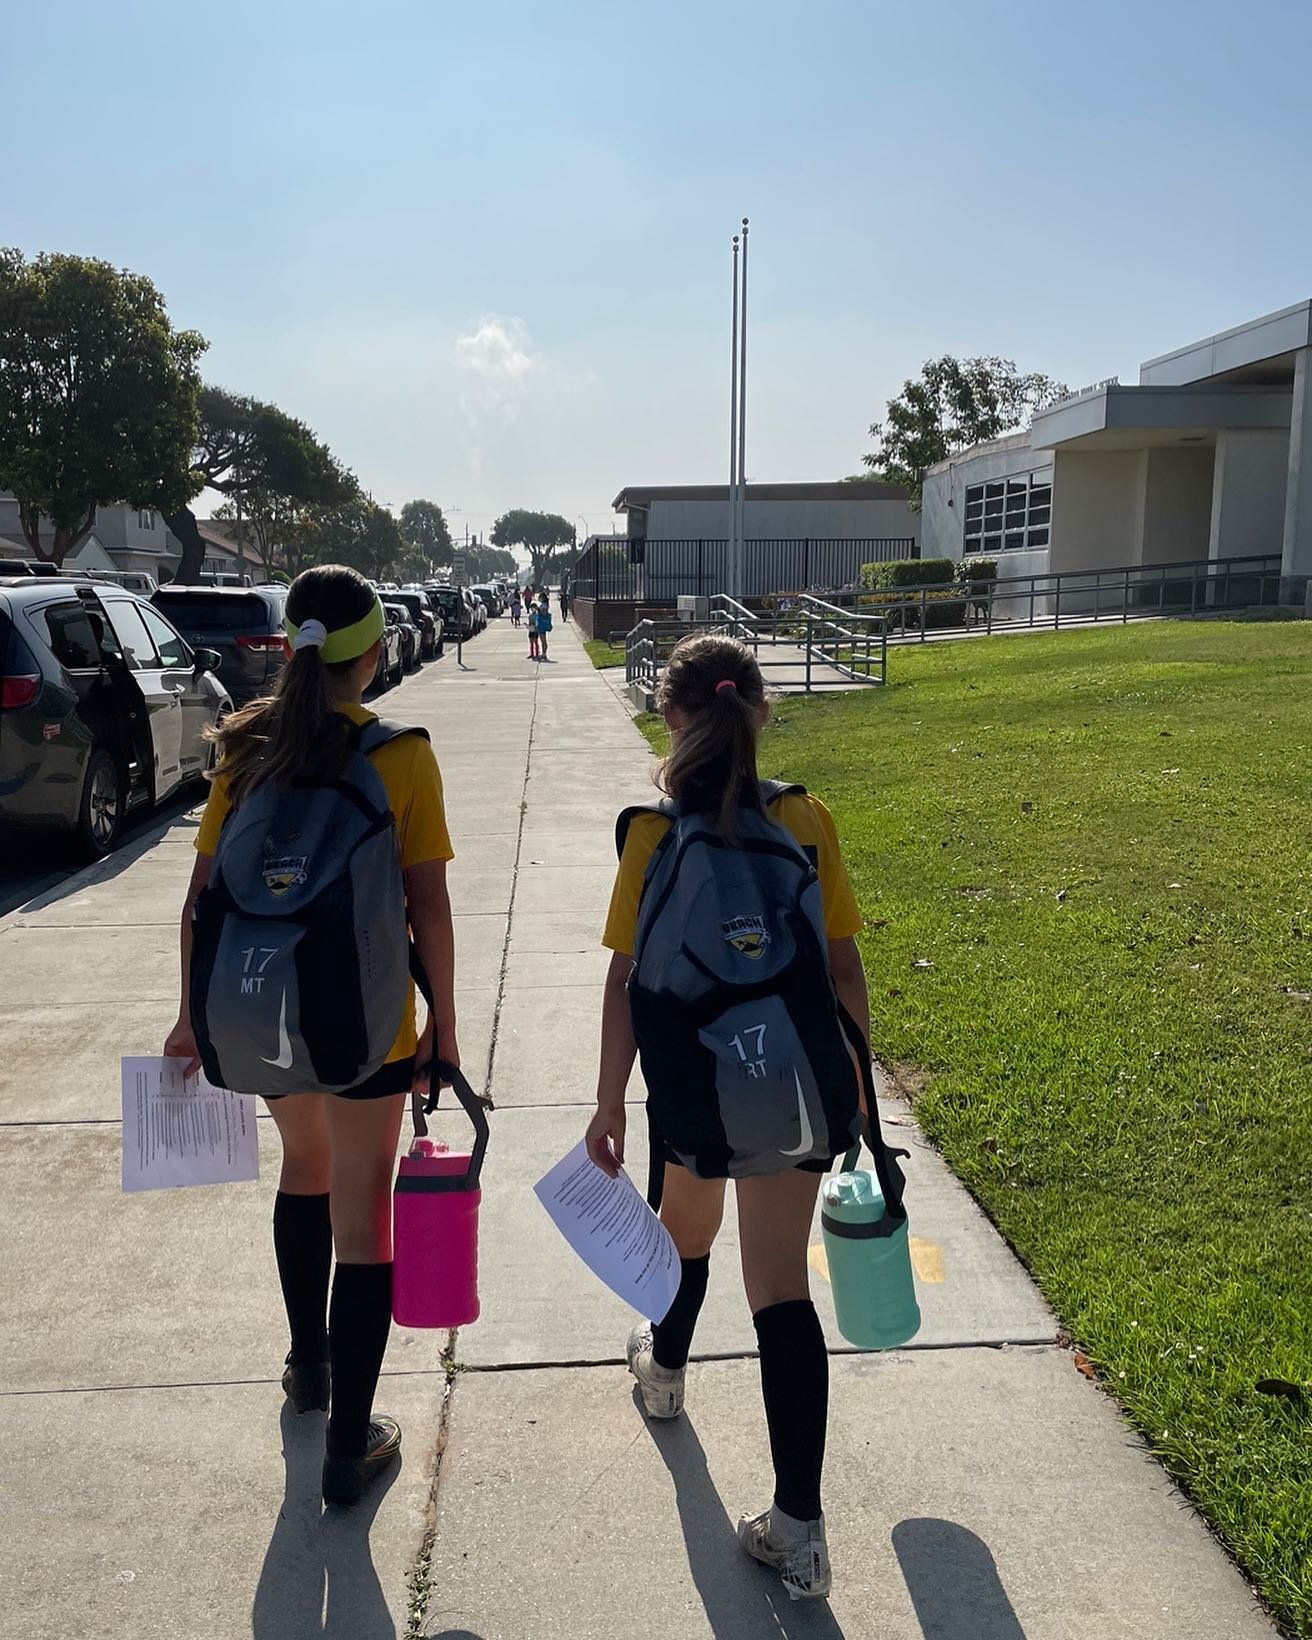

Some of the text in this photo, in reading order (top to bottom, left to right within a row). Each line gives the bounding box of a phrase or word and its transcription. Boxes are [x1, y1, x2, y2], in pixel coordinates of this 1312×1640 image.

[240, 947, 280, 973] 17
[240, 977, 266, 994] MT
[727, 1024, 767, 1061] 17
